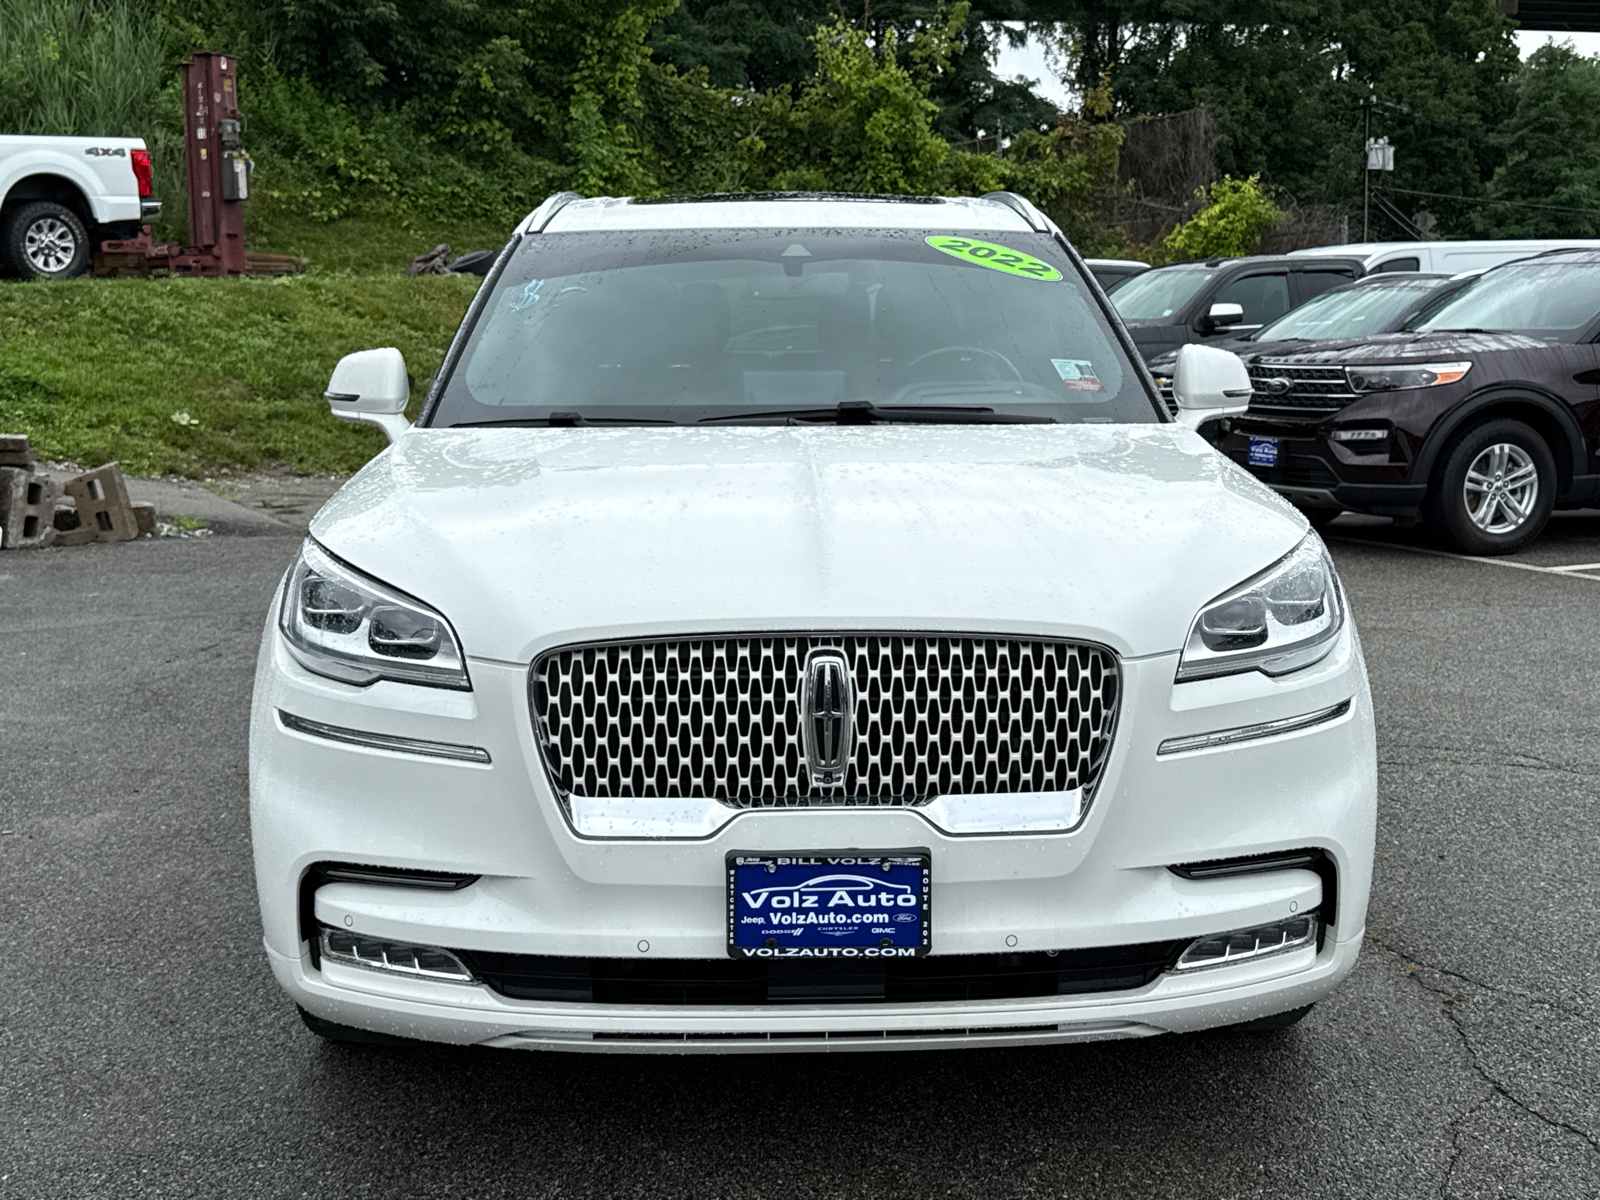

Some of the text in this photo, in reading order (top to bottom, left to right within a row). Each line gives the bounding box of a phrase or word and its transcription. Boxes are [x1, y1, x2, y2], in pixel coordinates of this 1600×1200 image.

[938, 239, 1052, 277] 2022
[777, 857, 822, 865] BILL
[741, 890, 917, 908] Volz Auto
[741, 916, 764, 925] Jeep
[769, 911, 889, 925] VolzAuto.com
[742, 948, 915, 957] VOLZAUTO.COM
